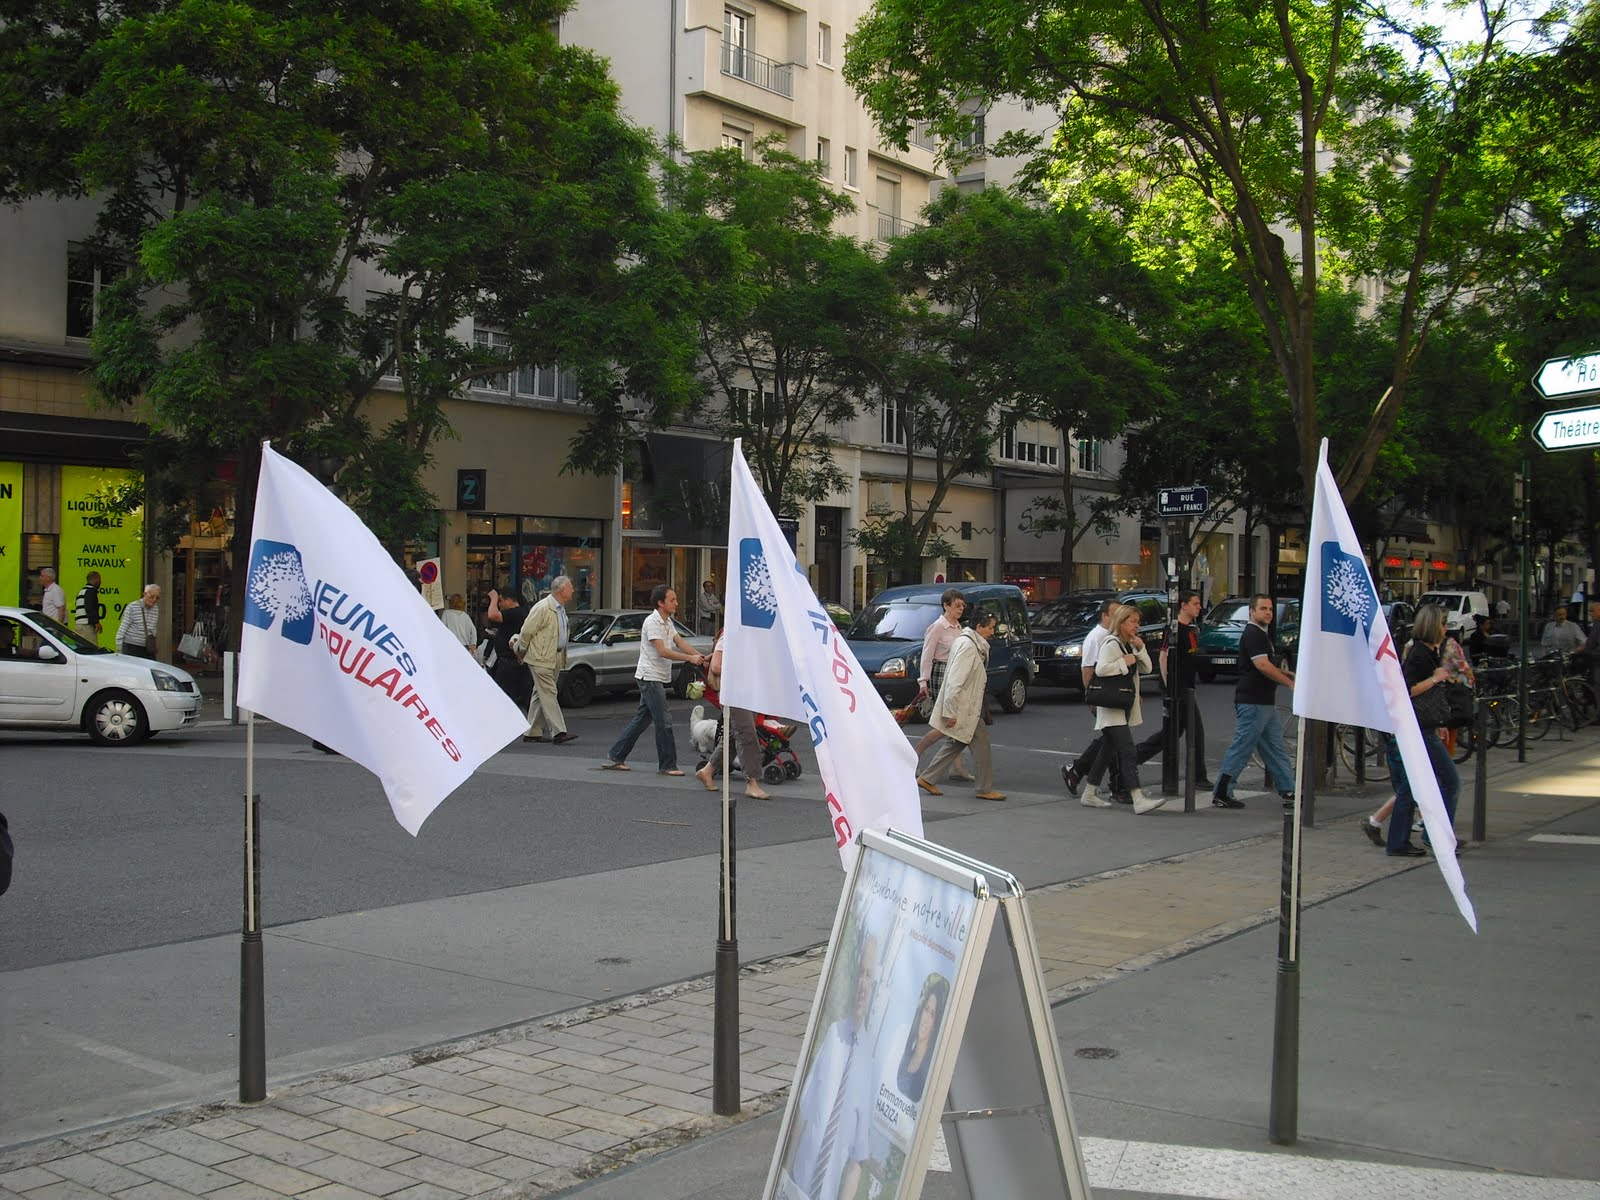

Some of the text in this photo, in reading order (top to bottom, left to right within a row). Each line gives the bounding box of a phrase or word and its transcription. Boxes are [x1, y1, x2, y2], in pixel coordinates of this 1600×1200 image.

[1553, 419, 1600, 439] Théâtre
[1180, 493, 1195, 502] RUE
[1183, 503, 1203, 511] FRANCE
[81, 516, 123, 528] TOALE
[82, 544, 117, 555] AVANT
[77, 557, 126, 569] TRAVAUX
[319, 622, 462, 763] PULAIRES
[913, 895, 942, 929] notre
[943, 903, 966, 941] ville
[879, 1082, 918, 1121] Emmanuelle
[875, 1098, 899, 1125] HAZIZA
